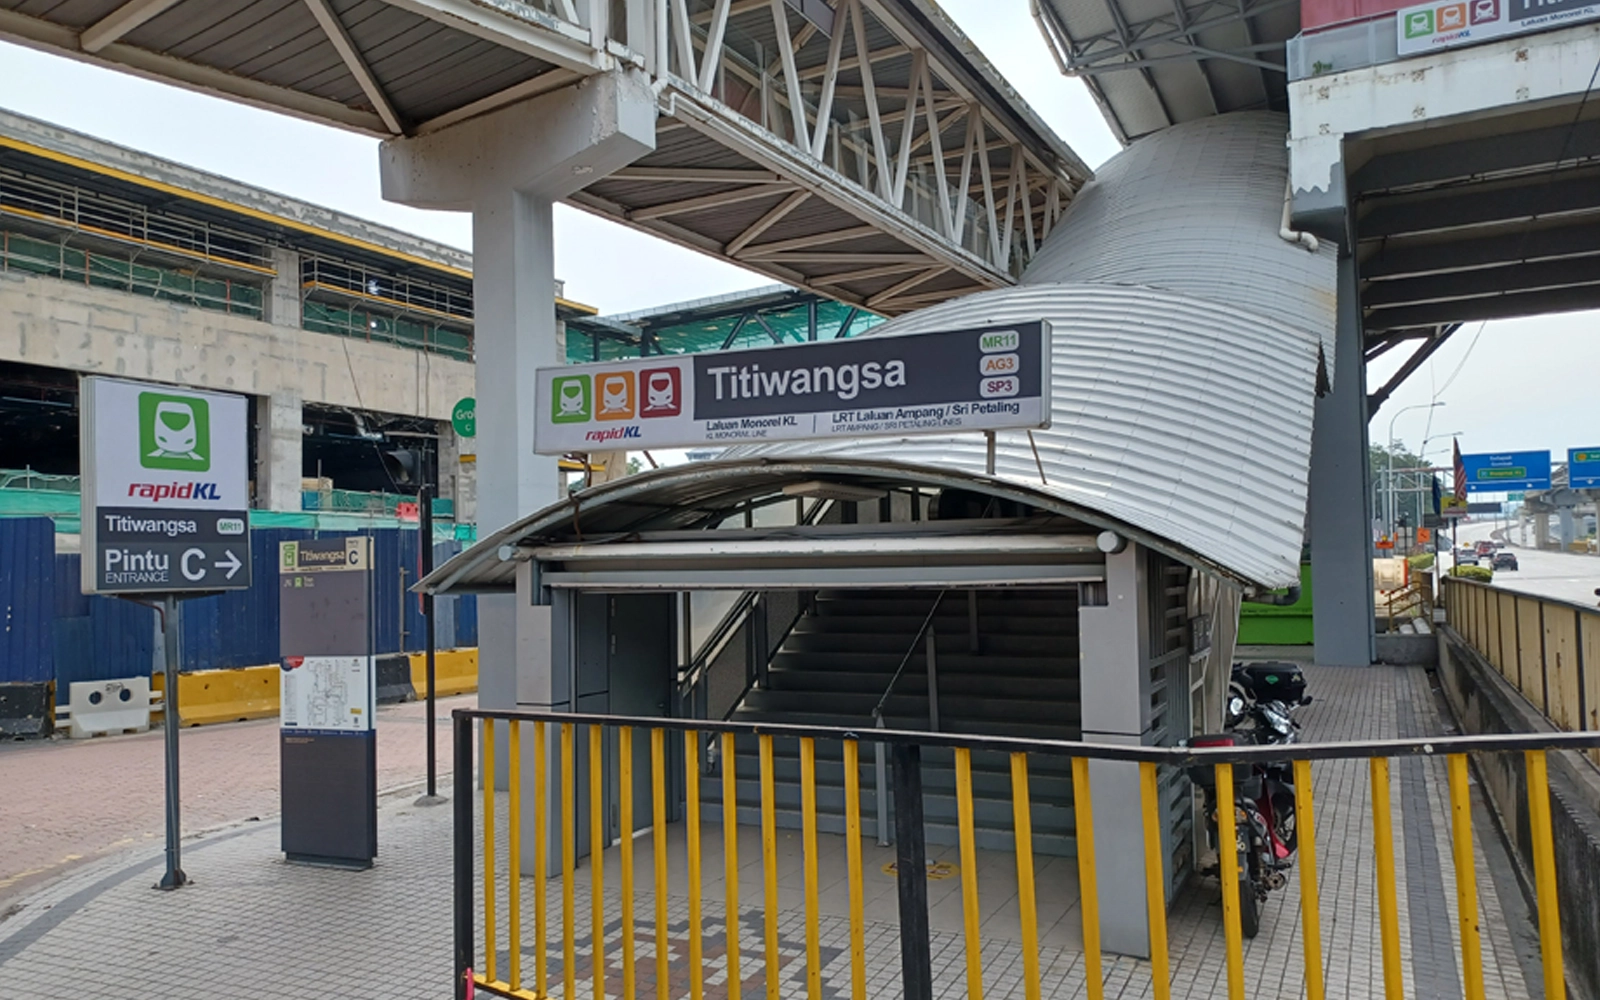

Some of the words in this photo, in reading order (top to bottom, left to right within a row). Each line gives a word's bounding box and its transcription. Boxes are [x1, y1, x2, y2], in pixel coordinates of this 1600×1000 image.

[982, 333, 1016, 349] MR11
[985, 357, 1014, 372] AG3
[706, 359, 906, 401] Titiwangsa
[987, 380, 1013, 393] SP3
[832, 411, 854, 423] LRT
[856, 409, 893, 422] Laluan
[895, 407, 944, 421] Ampang
[952, 404, 969, 416] Sri
[971, 401, 1020, 415] Petaling
[706, 420, 739, 431] Laluan
[740, 416, 781, 428] Monorel
[783, 416, 798, 426] KL
[584, 426, 642, 443] rapidKL
[128, 482, 221, 502] rapidKL
[105, 515, 197, 537] Titiwangsa
[219, 521, 242, 531] MR11
[105, 549, 169, 571] Pintu
[180, 548, 206, 581] C
[348, 550, 358, 565] C
[105, 571, 169, 583] ENTRANCE
